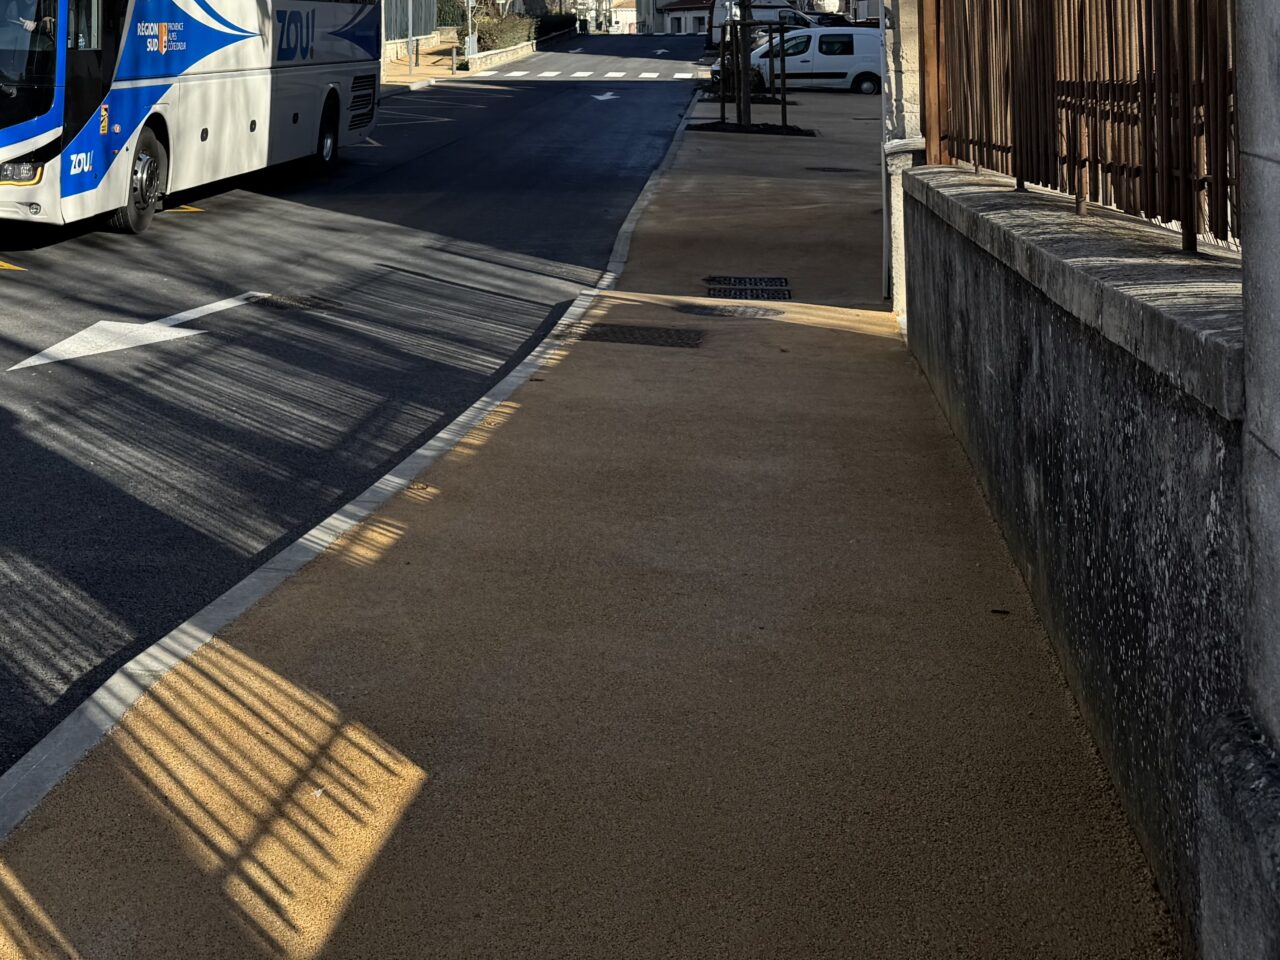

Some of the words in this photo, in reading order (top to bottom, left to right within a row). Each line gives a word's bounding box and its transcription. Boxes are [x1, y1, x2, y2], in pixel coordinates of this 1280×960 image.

[137, 20, 159, 36] RÉGION
[276, 7, 316, 61] ZOU!
[146, 38, 159, 52] SUD
[70, 149, 94, 176] ZOU!
